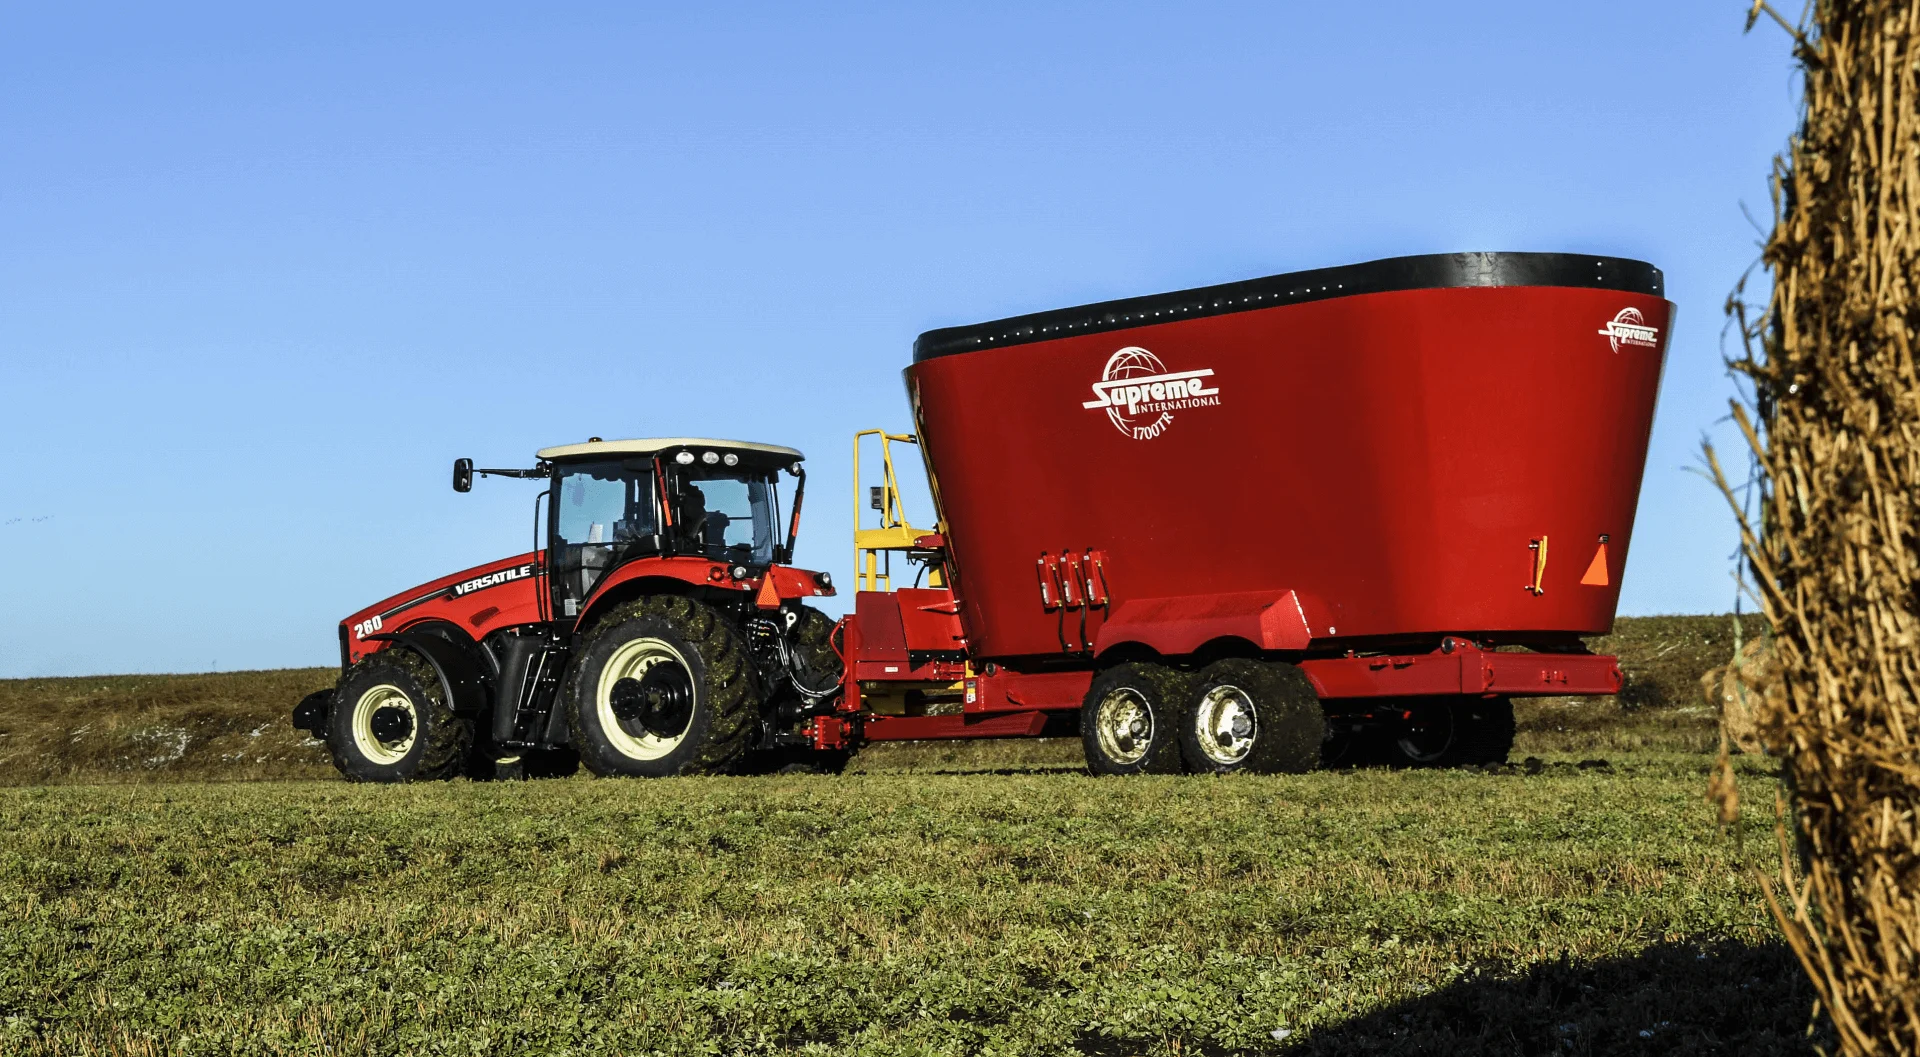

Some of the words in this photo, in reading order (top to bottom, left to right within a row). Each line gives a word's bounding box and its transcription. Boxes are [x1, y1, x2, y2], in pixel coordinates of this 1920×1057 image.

[1598, 321, 1658, 344] Supreme
[1082, 368, 1220, 415] Supreme
[1136, 396, 1221, 414] INTERNATIONAL
[1133, 411, 1174, 440] 1700TR
[455, 565, 531, 595] VERSATILE
[354, 615, 383, 640] 260
